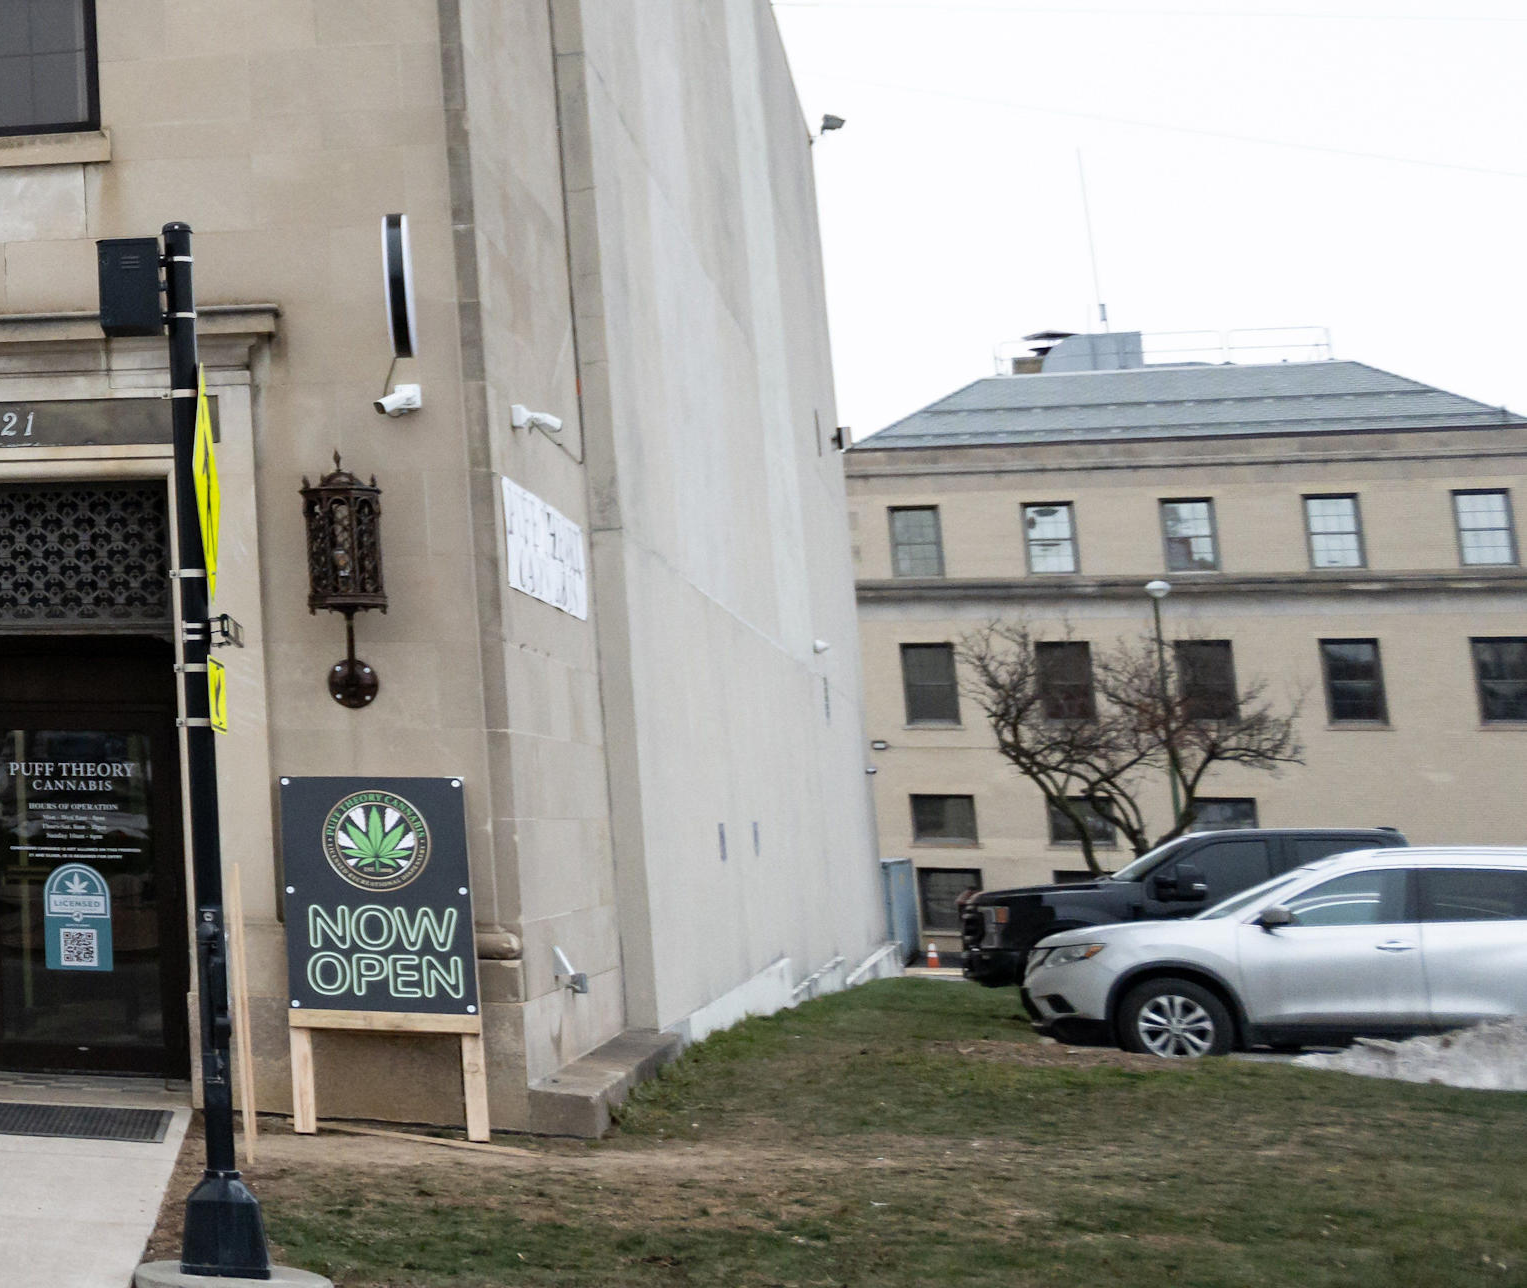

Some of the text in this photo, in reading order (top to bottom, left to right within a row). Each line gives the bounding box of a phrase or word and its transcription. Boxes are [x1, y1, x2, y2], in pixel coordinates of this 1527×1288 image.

[9, 762, 135, 777] PUFF THEORY
[32, 779, 113, 791] CANNABIS
[28, 802, 57, 810] HOURS
[327, 793, 426, 838] PUFF THEORY CANNABIS
[54, 900, 100, 908] LICENSED
[308, 904, 458, 952] NOW
[307, 951, 465, 999] OPEN
